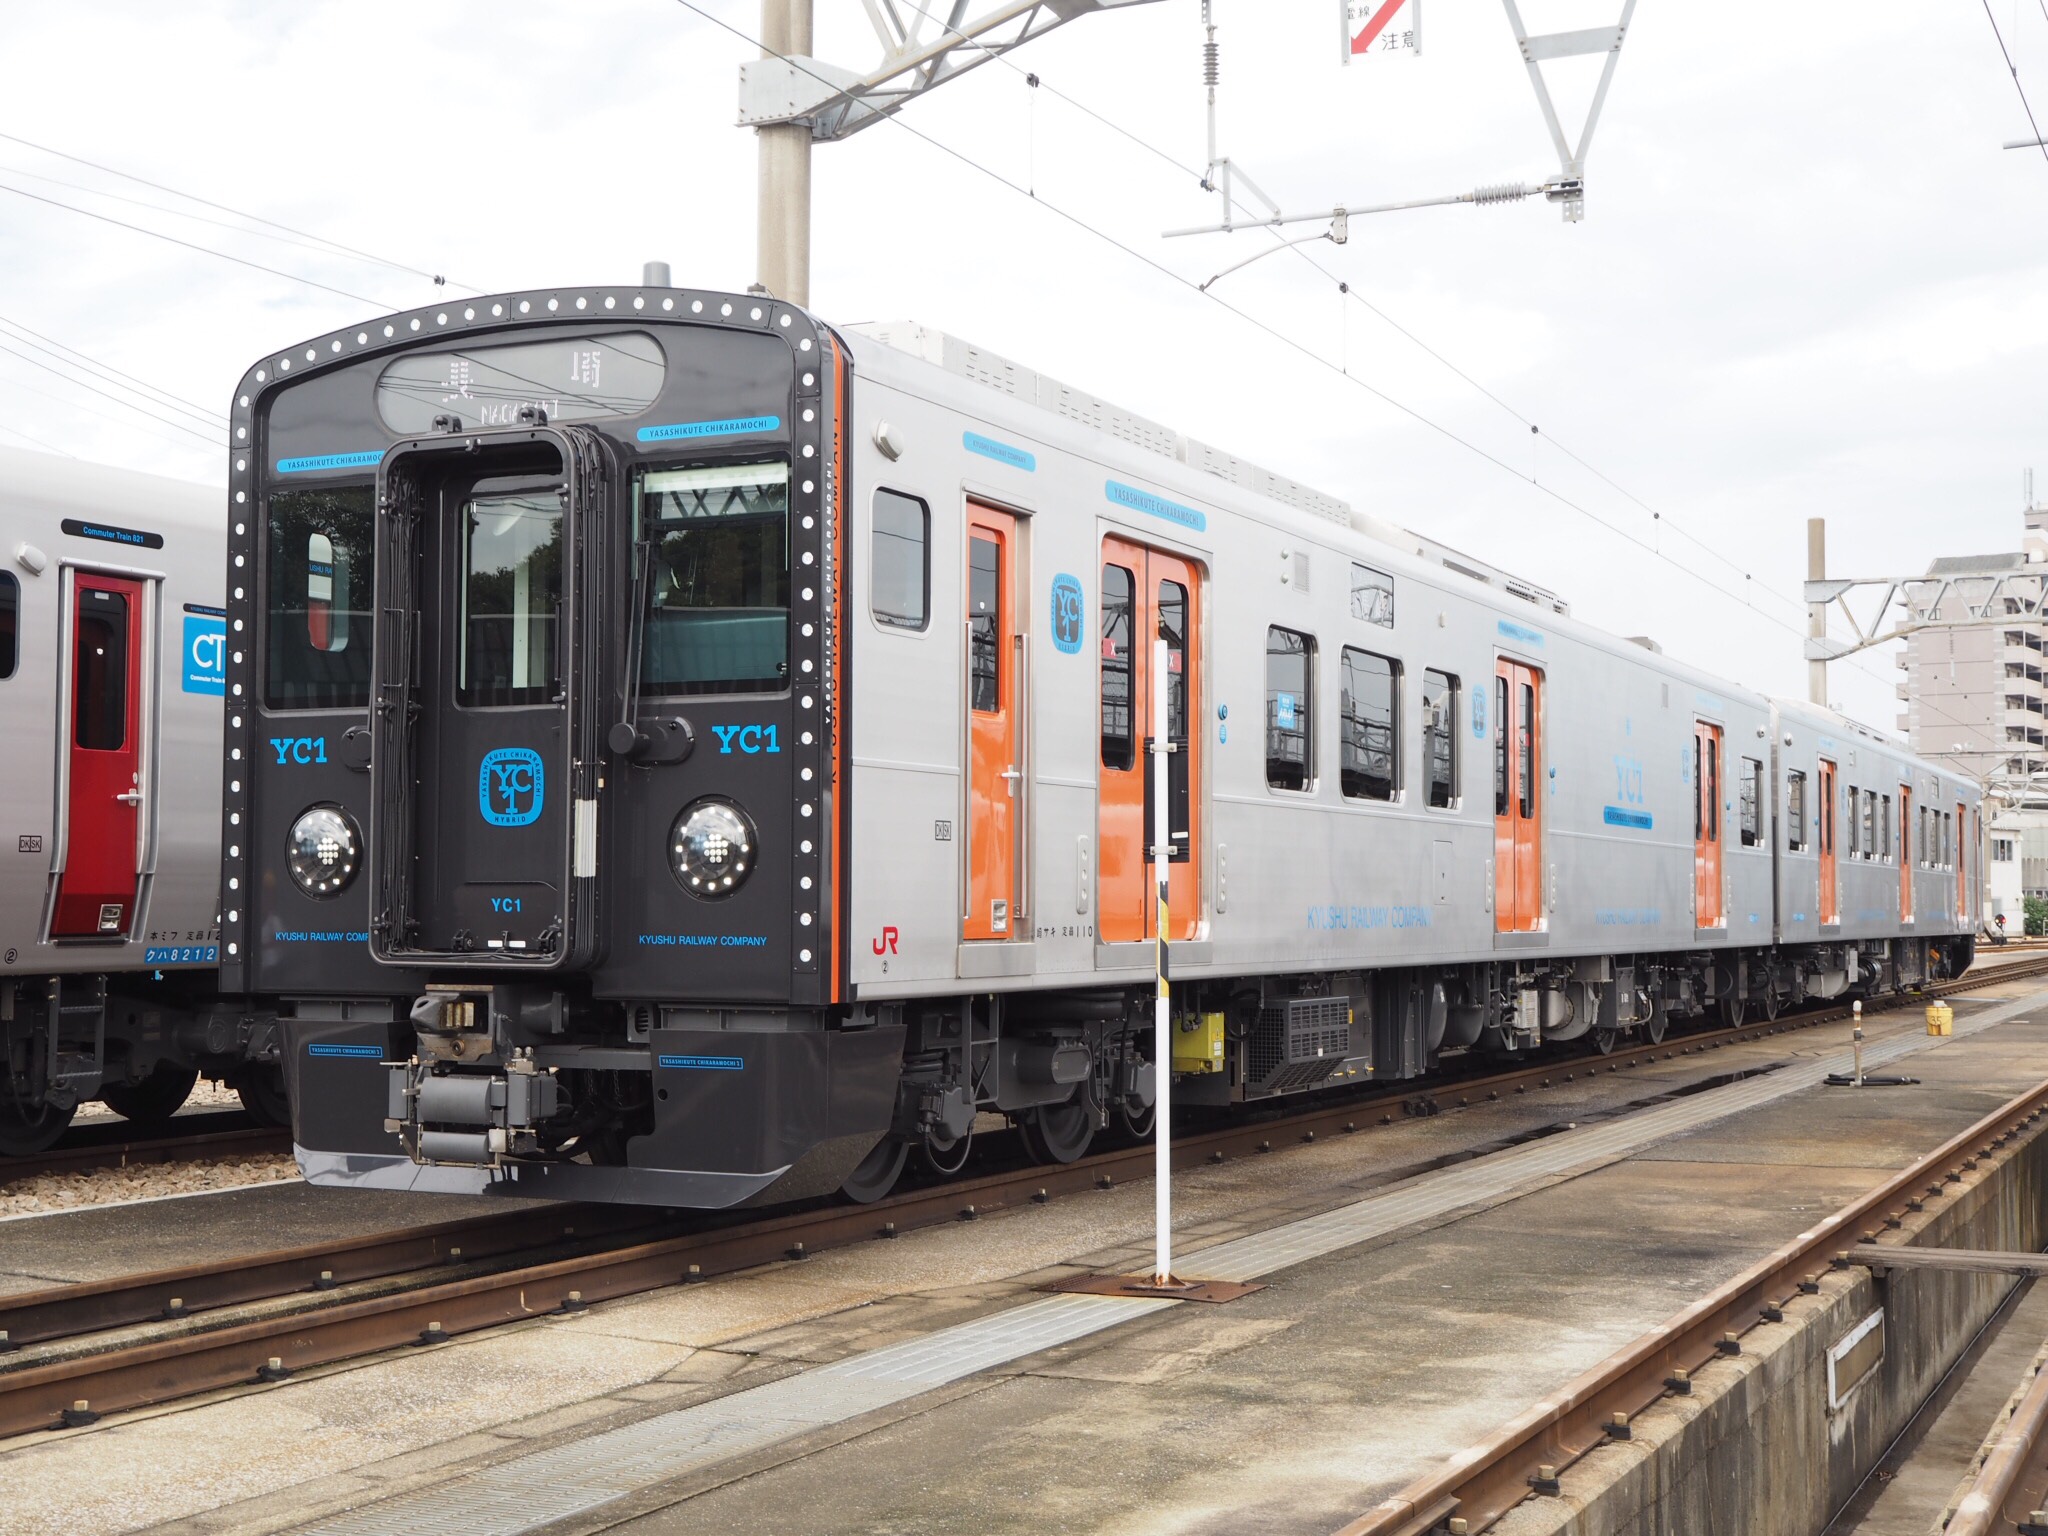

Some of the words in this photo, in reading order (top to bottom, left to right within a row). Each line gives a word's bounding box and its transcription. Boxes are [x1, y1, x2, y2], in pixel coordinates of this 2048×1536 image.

[649, 426, 703, 438] YASASHIKUTE
[705, 420, 767, 432] CHIKARAMOCHI
[288, 458, 334, 469] YASASHIKUTE
[1114, 487, 1155, 512] YASASHIKUTE
[82, 526, 115, 539] Commuter
[115, 531, 132, 542] Train
[132, 534, 144, 543] 821
[712, 724, 781, 754] YC1
[269, 736, 328, 764] YC1
[20, 839, 30, 849] DK
[31, 839, 41, 849] SK
[491, 898, 522, 913] YC1
[1306, 905, 1349, 929] KYUSHU
[275, 931, 308, 942] KYUSHU
[310, 931, 344, 942] RAILWAY
[639, 935, 676, 945] KYUSHU
[679, 935, 718, 945] RAILWAY
[720, 936, 767, 946] COMPANY
[873, 926, 898, 956] JR
